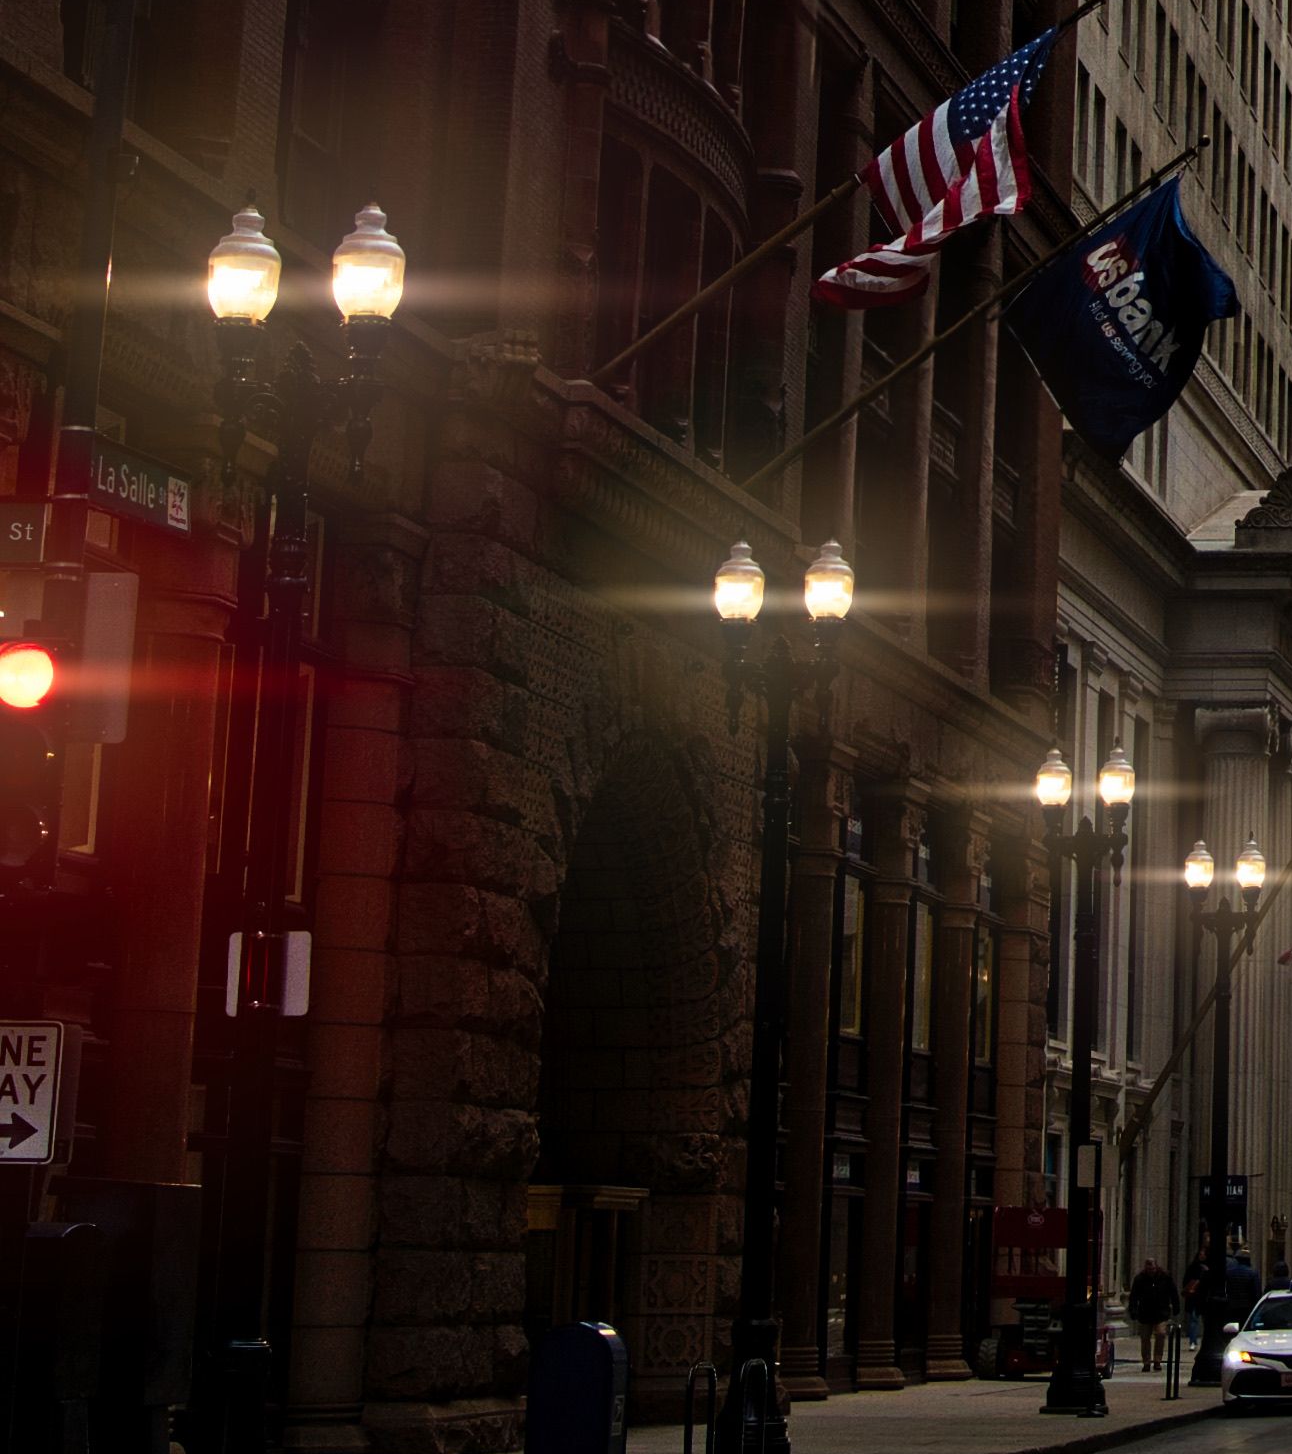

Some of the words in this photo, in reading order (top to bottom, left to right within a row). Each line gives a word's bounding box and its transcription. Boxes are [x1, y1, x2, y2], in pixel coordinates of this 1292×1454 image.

[1101, 321, 1117, 338] us
[97, 455, 116, 494] La
[119, 463, 156, 509] Salle
[9, 522, 34, 541] St
[0, 1035, 47, 1066] NE
[0, 1073, 47, 1105] AY
